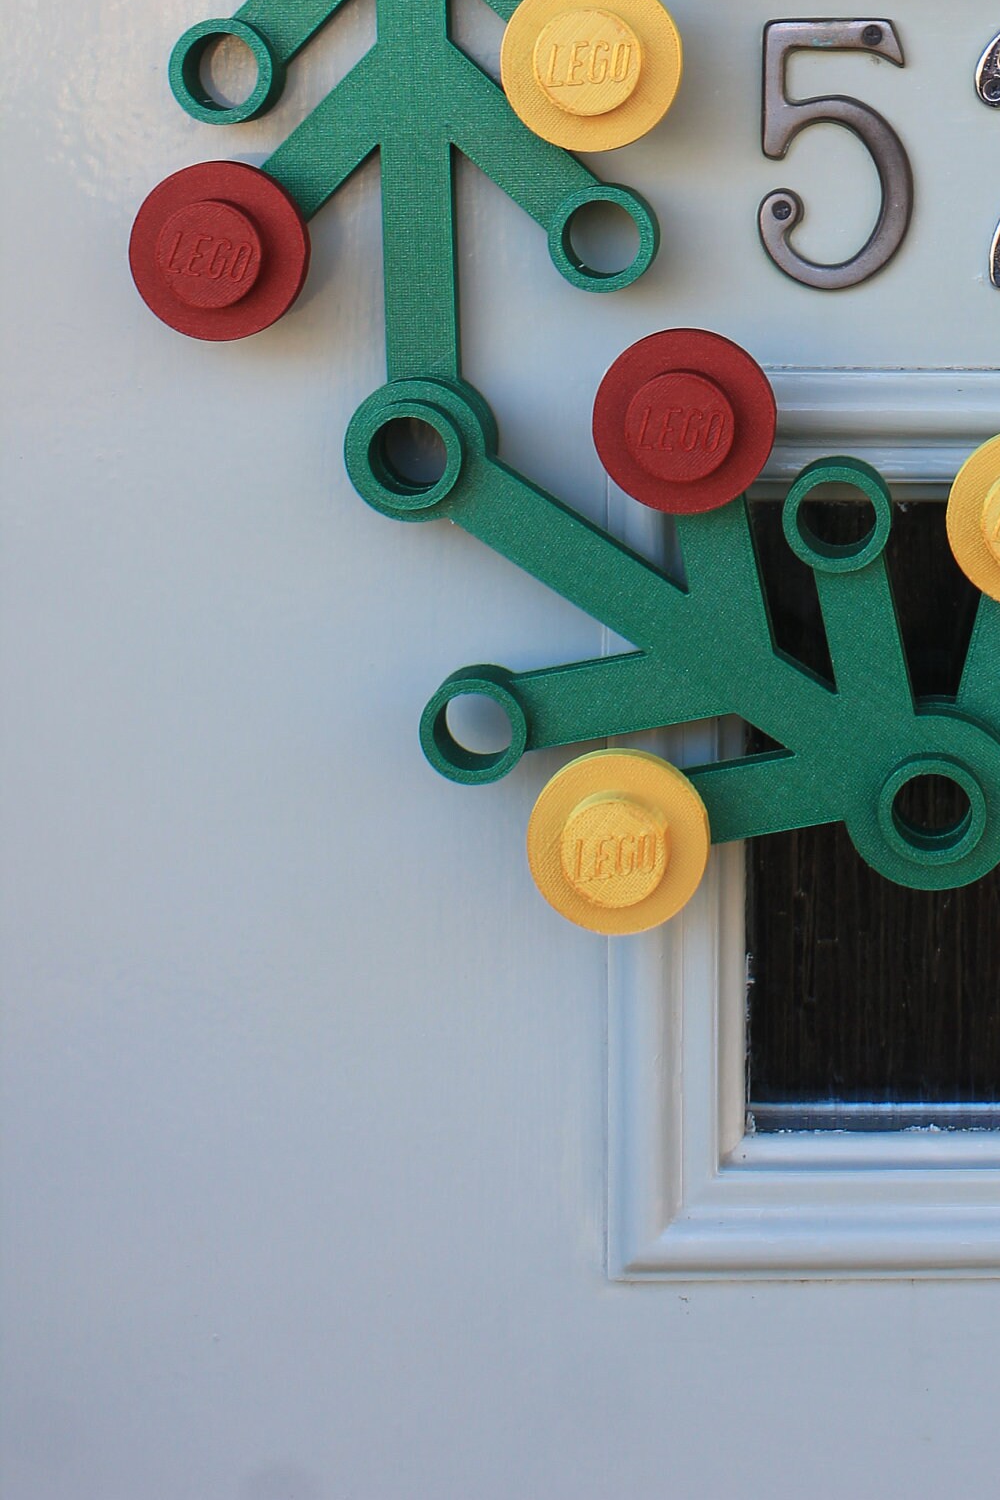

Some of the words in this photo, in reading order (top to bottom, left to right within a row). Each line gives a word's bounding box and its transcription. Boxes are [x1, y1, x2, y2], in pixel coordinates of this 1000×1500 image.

[547, 41, 632, 87] LEGO
[160, 234, 254, 282] LEGO
[635, 407, 725, 452] LEGO
[574, 832, 659, 882] LEGO
